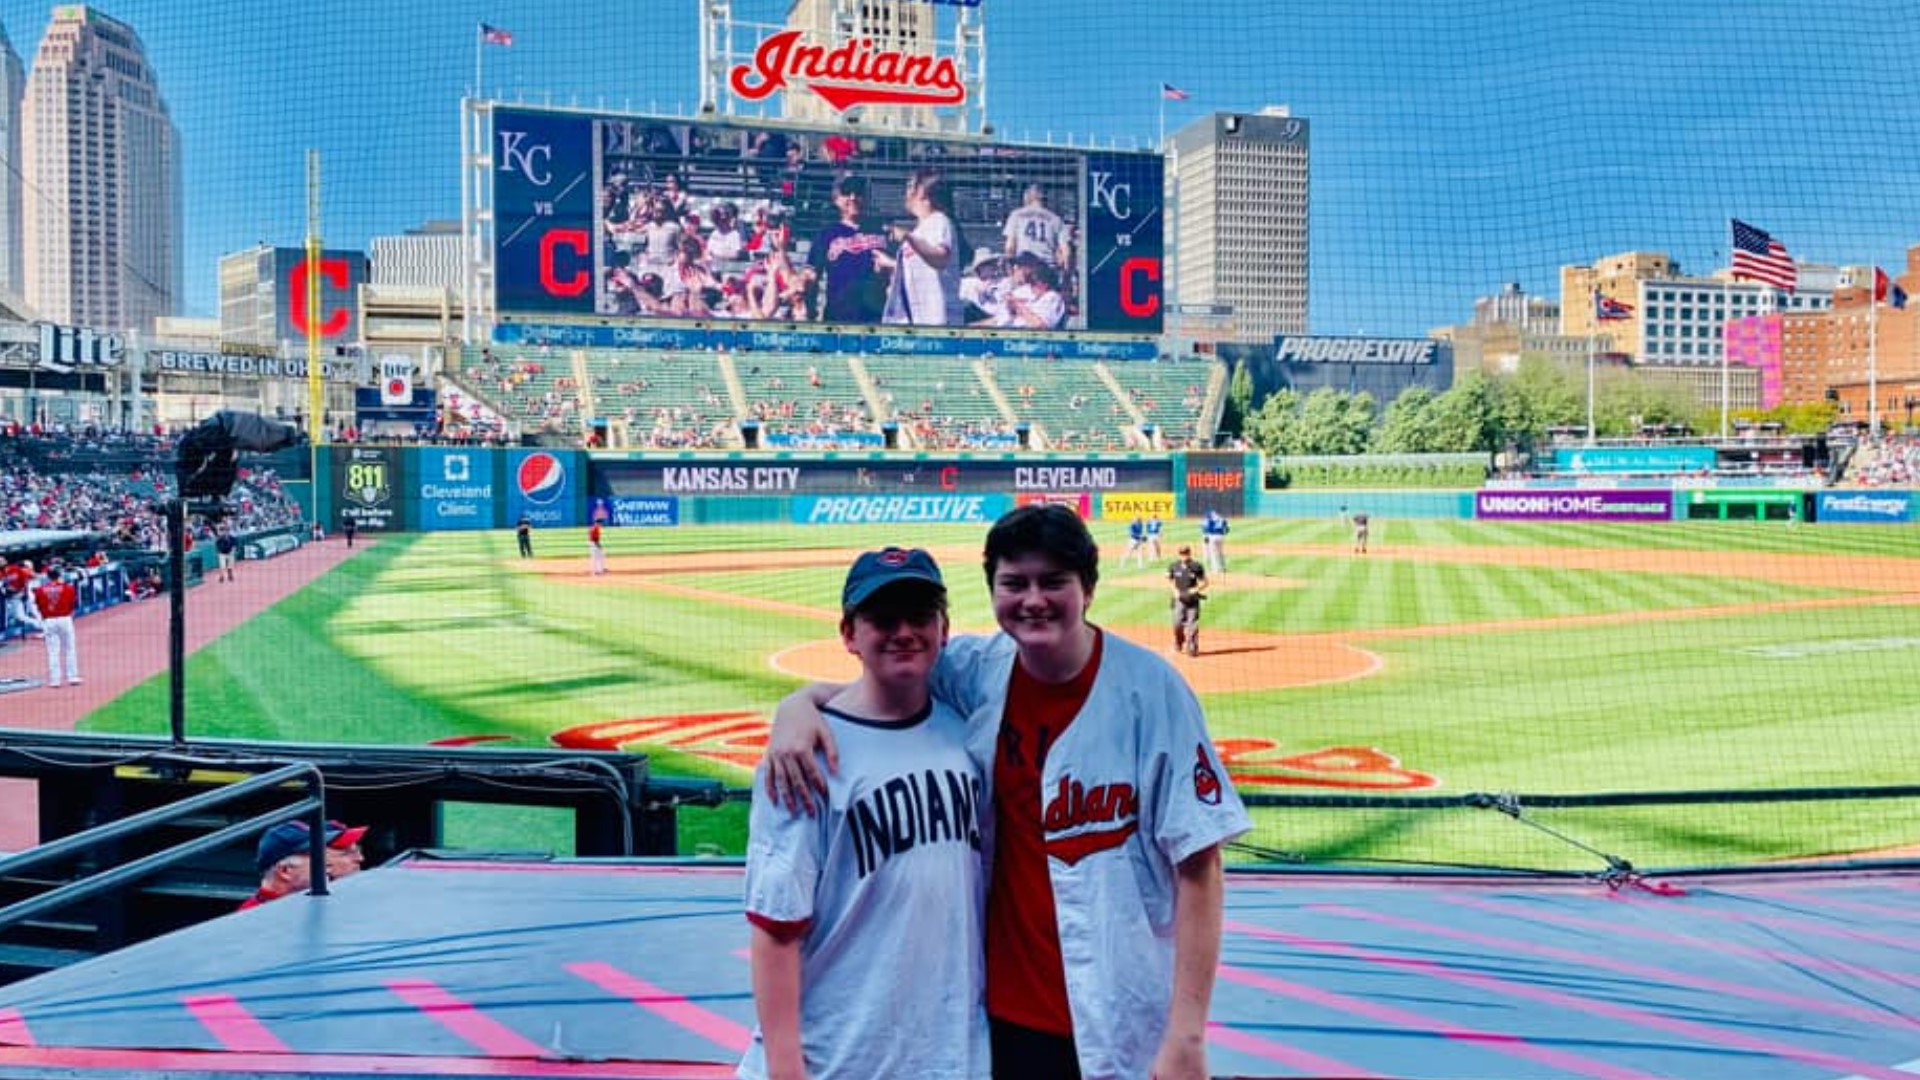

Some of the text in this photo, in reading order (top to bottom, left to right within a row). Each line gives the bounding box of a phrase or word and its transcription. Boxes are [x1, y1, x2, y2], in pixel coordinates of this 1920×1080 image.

[731, 31, 966, 110] Indians
[499, 131, 552, 186] KC
[1091, 172, 1132, 219] KC
[1024, 220, 1047, 242] 41
[539, 228, 590, 296] C
[289, 259, 351, 337] C
[1119, 257, 1160, 318] C
[38, 323, 125, 373] Lite
[1276, 336, 1437, 364] PROGRESSIVE
[162, 352, 331, 377] BREWED IN OHO
[349, 464, 384, 490] 811
[663, 467, 749, 491] KANSAS
[752, 467, 799, 490] CITY
[1015, 467, 1117, 489] CLEVELAND
[1187, 468, 1244, 492] meijer
[421, 484, 492, 499] Cleveland
[437, 501, 477, 516] Clinic
[808, 495, 985, 523] PROGRESSIVE
[1104, 501, 1173, 513] STANLEY
